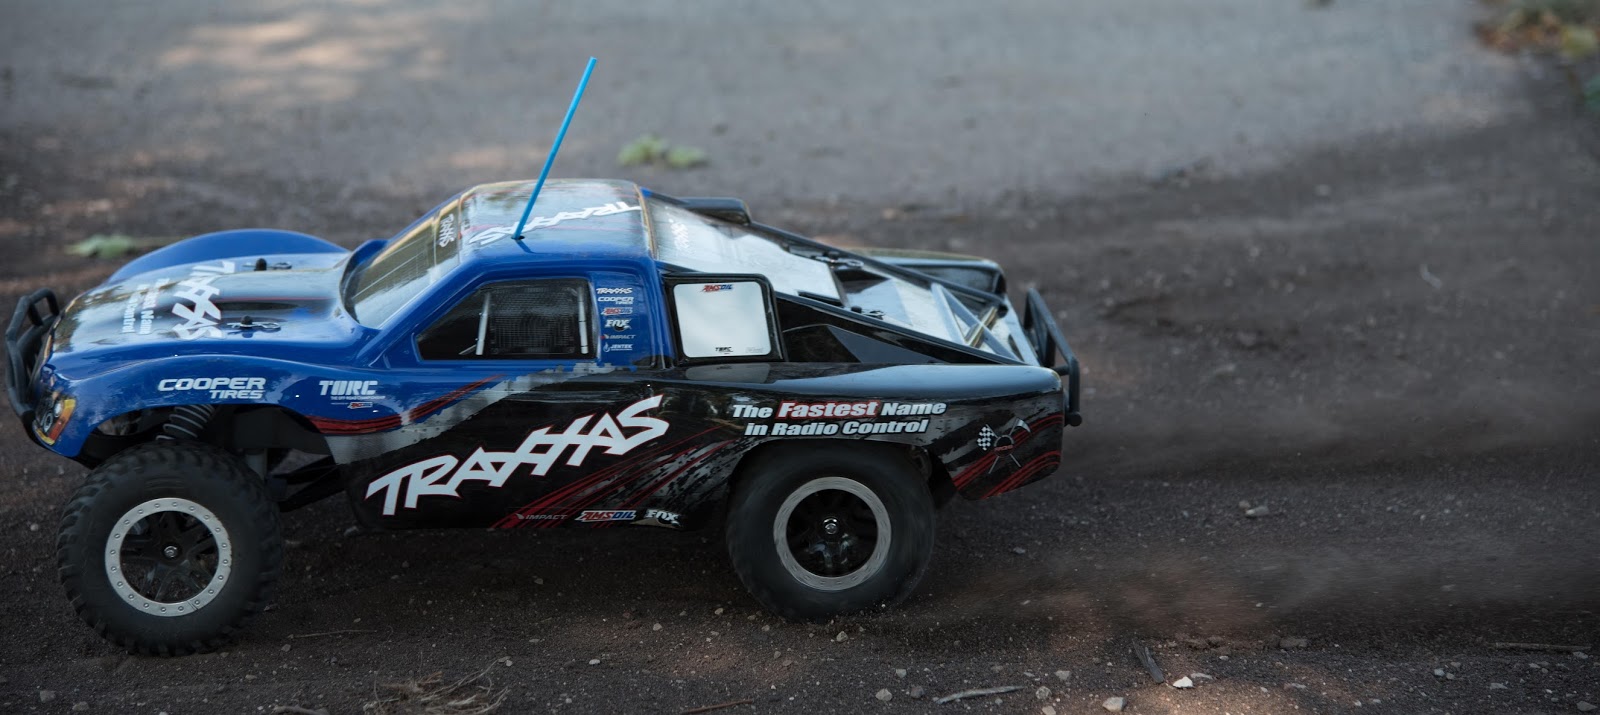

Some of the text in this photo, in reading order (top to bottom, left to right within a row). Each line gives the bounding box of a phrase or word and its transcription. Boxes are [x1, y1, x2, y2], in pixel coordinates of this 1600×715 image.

[701, 284, 733, 292] AMSOIL
[158, 377, 266, 391] COOPER
[319, 381, 378, 395] TORC
[209, 390, 265, 399] TIRES
[732, 400, 947, 418] The Fastest Name
[744, 419, 929, 436] in Radio Control
[365, 394, 670, 516] TRAXXAS
[575, 510, 637, 522] AMSOIL
[645, 509, 681, 526] FOX
